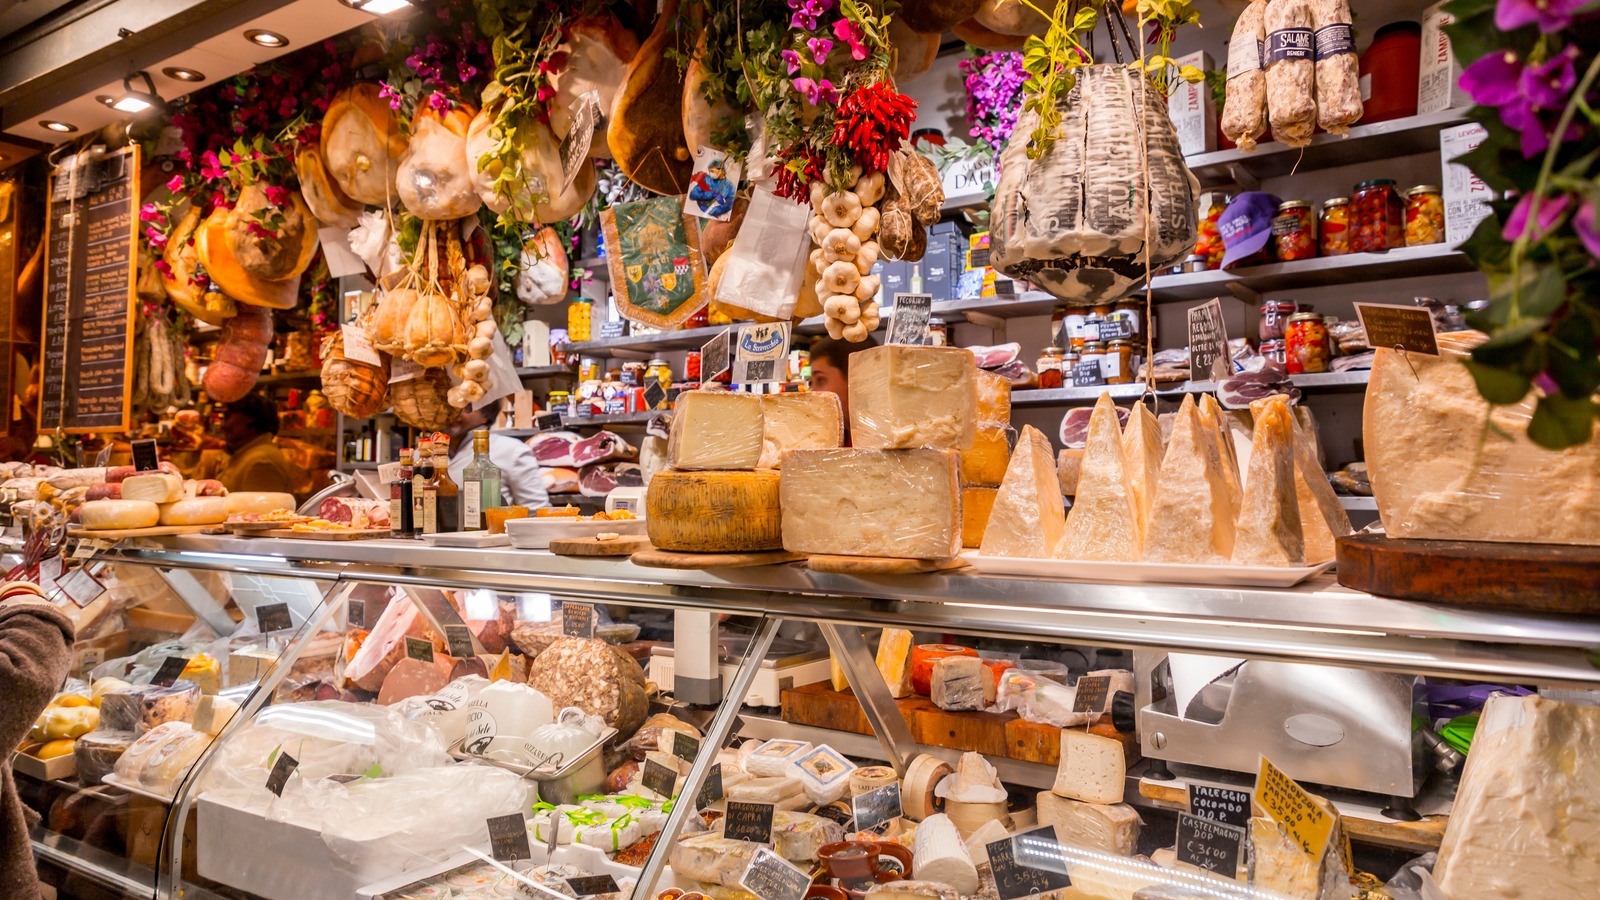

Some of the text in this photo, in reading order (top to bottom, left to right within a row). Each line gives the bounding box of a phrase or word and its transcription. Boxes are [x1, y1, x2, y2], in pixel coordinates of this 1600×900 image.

[1280, 33, 1310, 48] SALAME
[1195, 354, 1202, 368] €
[477, 722, 492, 735] Sele
[1194, 785, 1247, 803] TALEGGIO
[1267, 763, 1323, 820] GORGONZOLA
[1193, 797, 1243, 814] COLOMBO
[1265, 780, 1303, 822] TARTUFO
[1266, 773, 1317, 825] CREMOSO AL
[736, 812, 762, 822] CAPRA
[1182, 816, 1240, 842] CASTELMAGNO
[1193, 829, 1214, 841] DOP
[1292, 830, 1301, 842] AL
[1187, 840, 1194, 852] €
[1190, 853, 1201, 862] AL
[777, 863, 800, 883] BLANC
[1003, 876, 1010, 888] €
